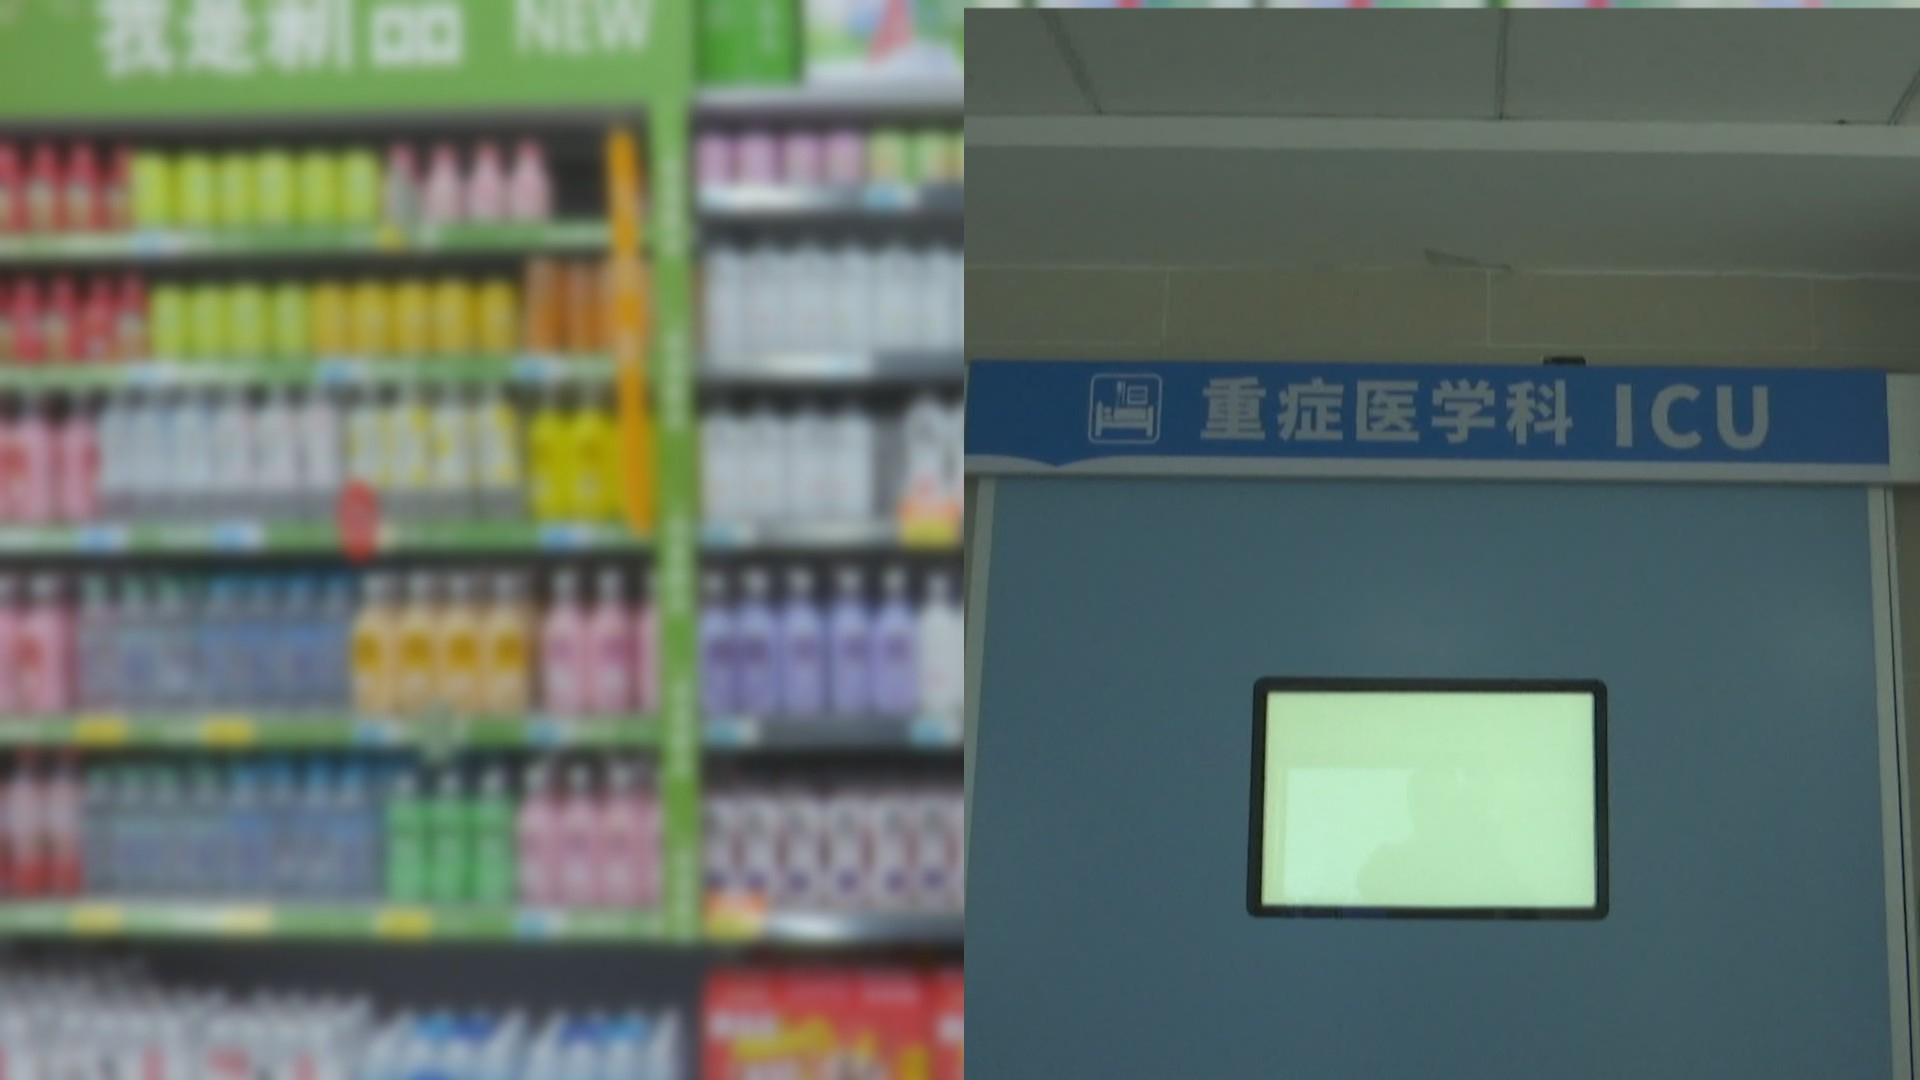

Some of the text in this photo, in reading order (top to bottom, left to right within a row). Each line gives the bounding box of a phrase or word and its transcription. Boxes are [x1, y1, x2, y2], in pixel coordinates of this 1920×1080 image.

[515, 0, 652, 52] NEW
[1200, 376, 1770, 450] 重症医学科 ICU
